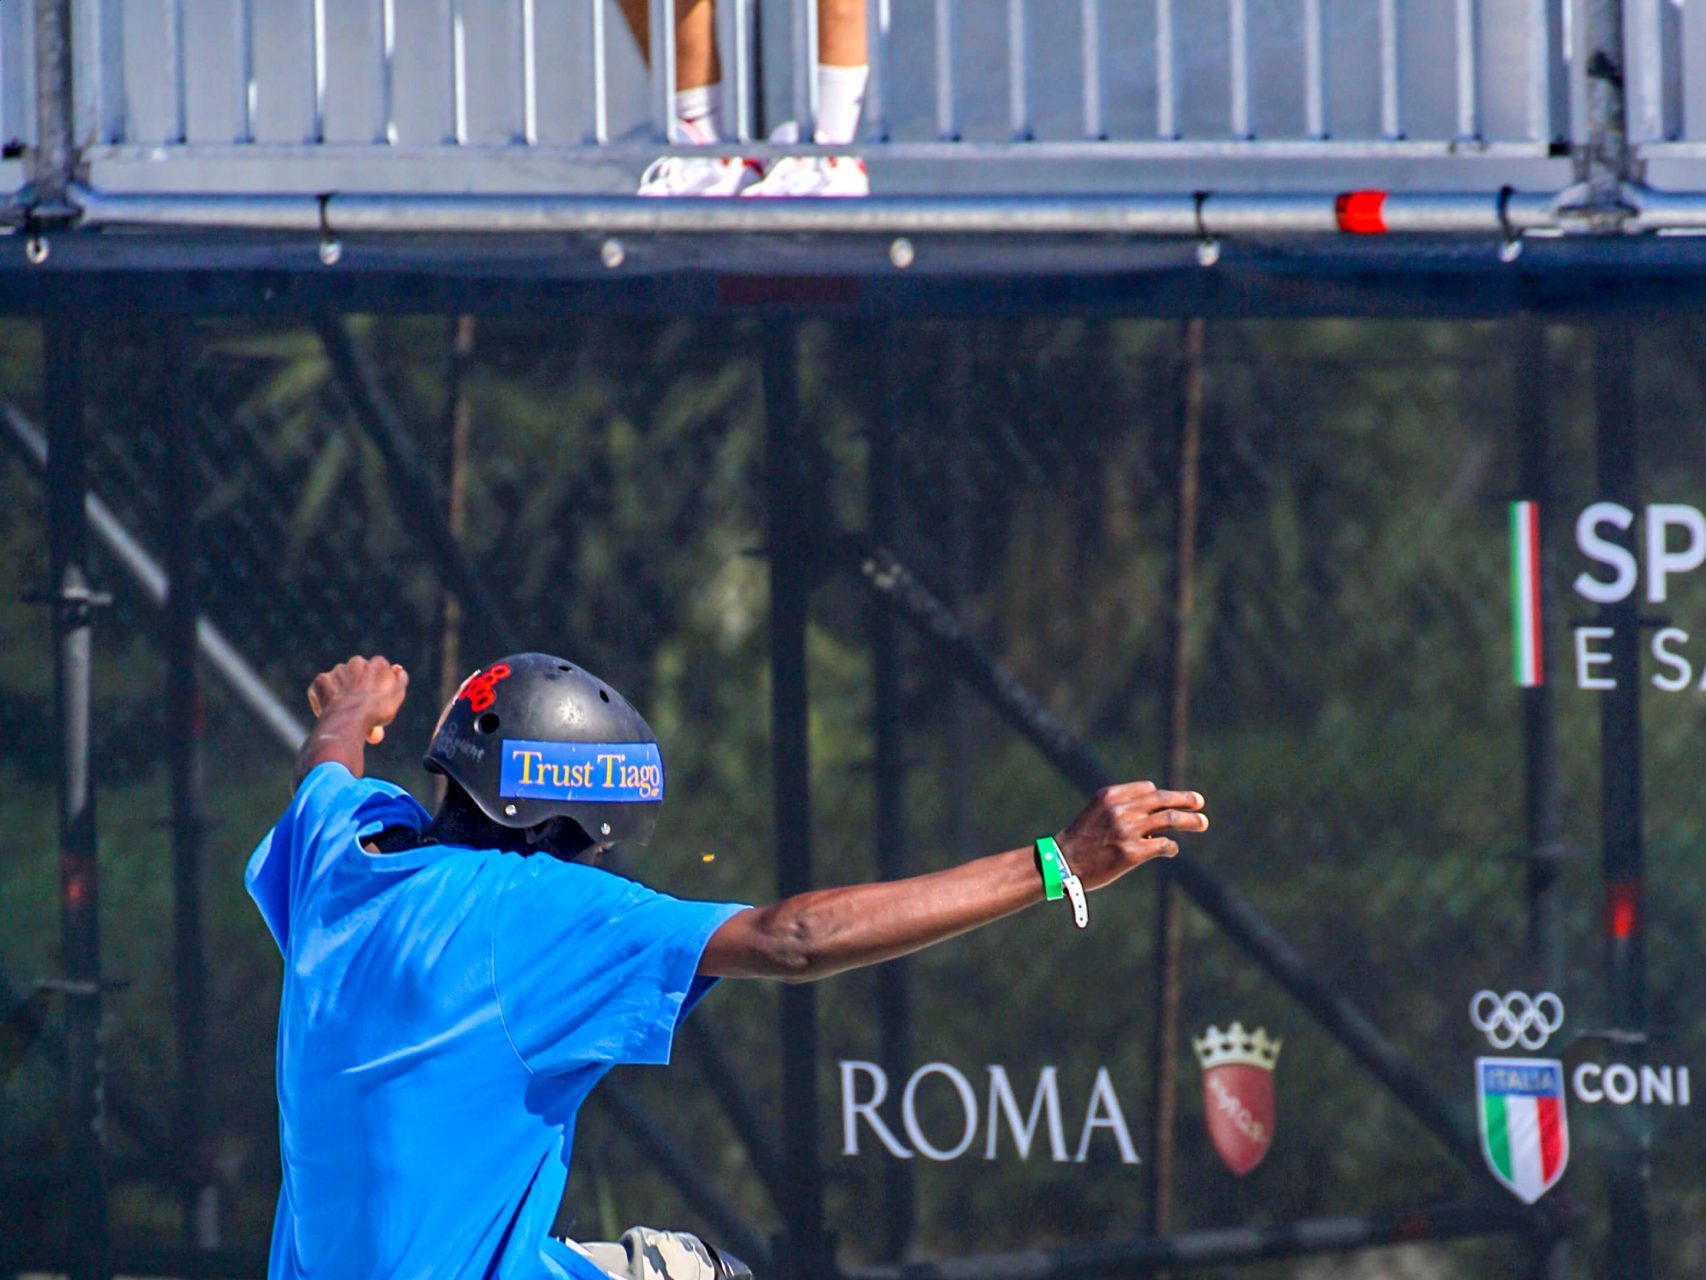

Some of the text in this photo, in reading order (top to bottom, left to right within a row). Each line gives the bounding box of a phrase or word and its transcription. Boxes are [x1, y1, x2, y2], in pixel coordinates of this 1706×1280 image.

[1573, 501, 1706, 604] SP
[1575, 626, 1706, 692] E S
[512, 750, 595, 785] Trust
[597, 754, 660, 798] Tiago
[1486, 1068, 1554, 1092] ITALIA
[1572, 1062, 1691, 1106] CONI
[839, 1060, 1142, 1164] ROMA
